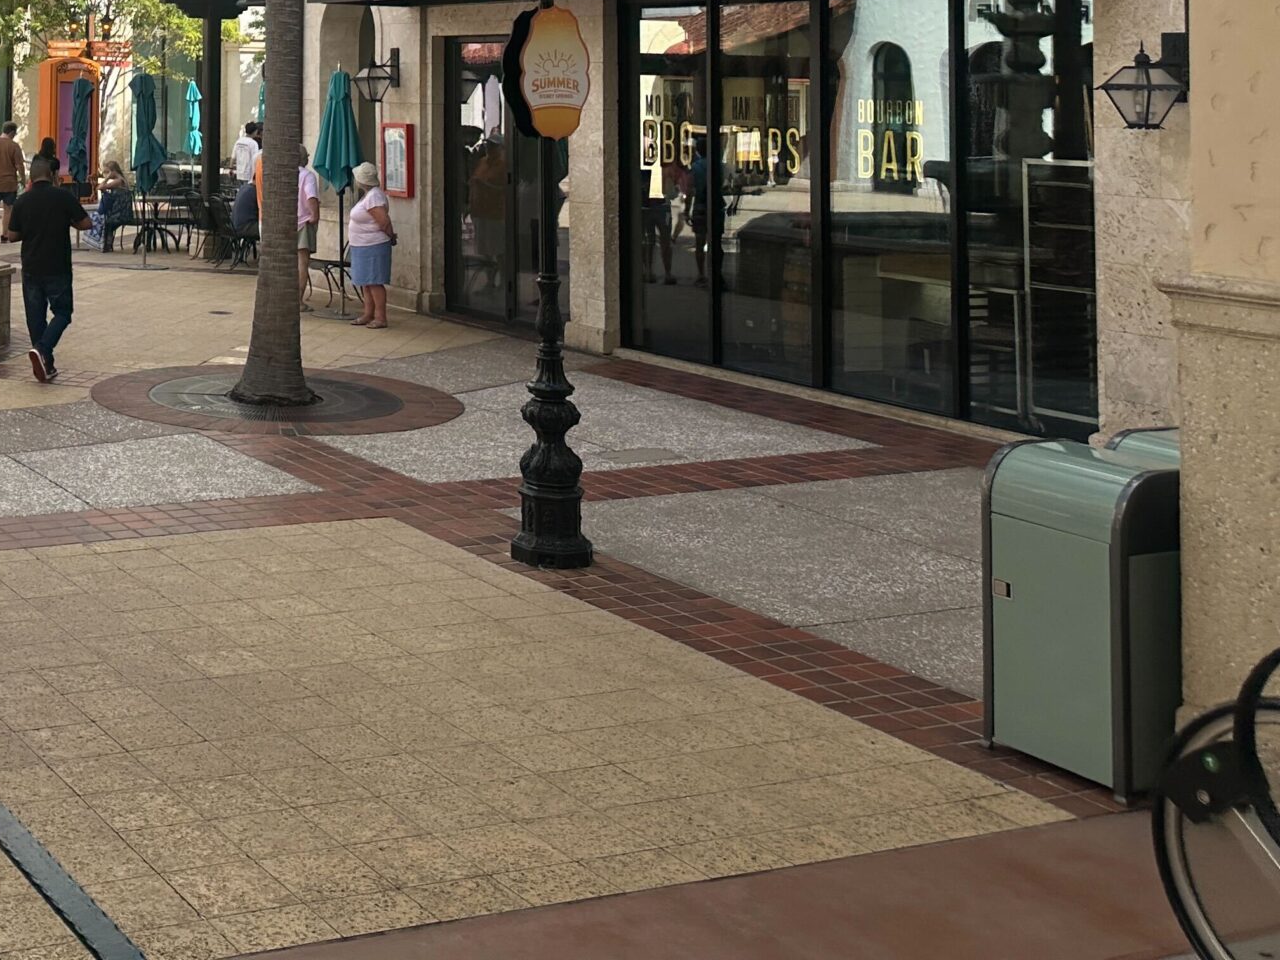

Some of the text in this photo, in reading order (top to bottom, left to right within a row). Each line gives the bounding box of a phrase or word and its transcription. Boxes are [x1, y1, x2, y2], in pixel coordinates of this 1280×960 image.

[531, 76, 580, 93] SUMMER
[858, 99, 923, 125] BOURBON
[643, 119, 693, 170] BBQ
[733, 125, 800, 175] TAPS
[857, 128, 925, 183] BAR
